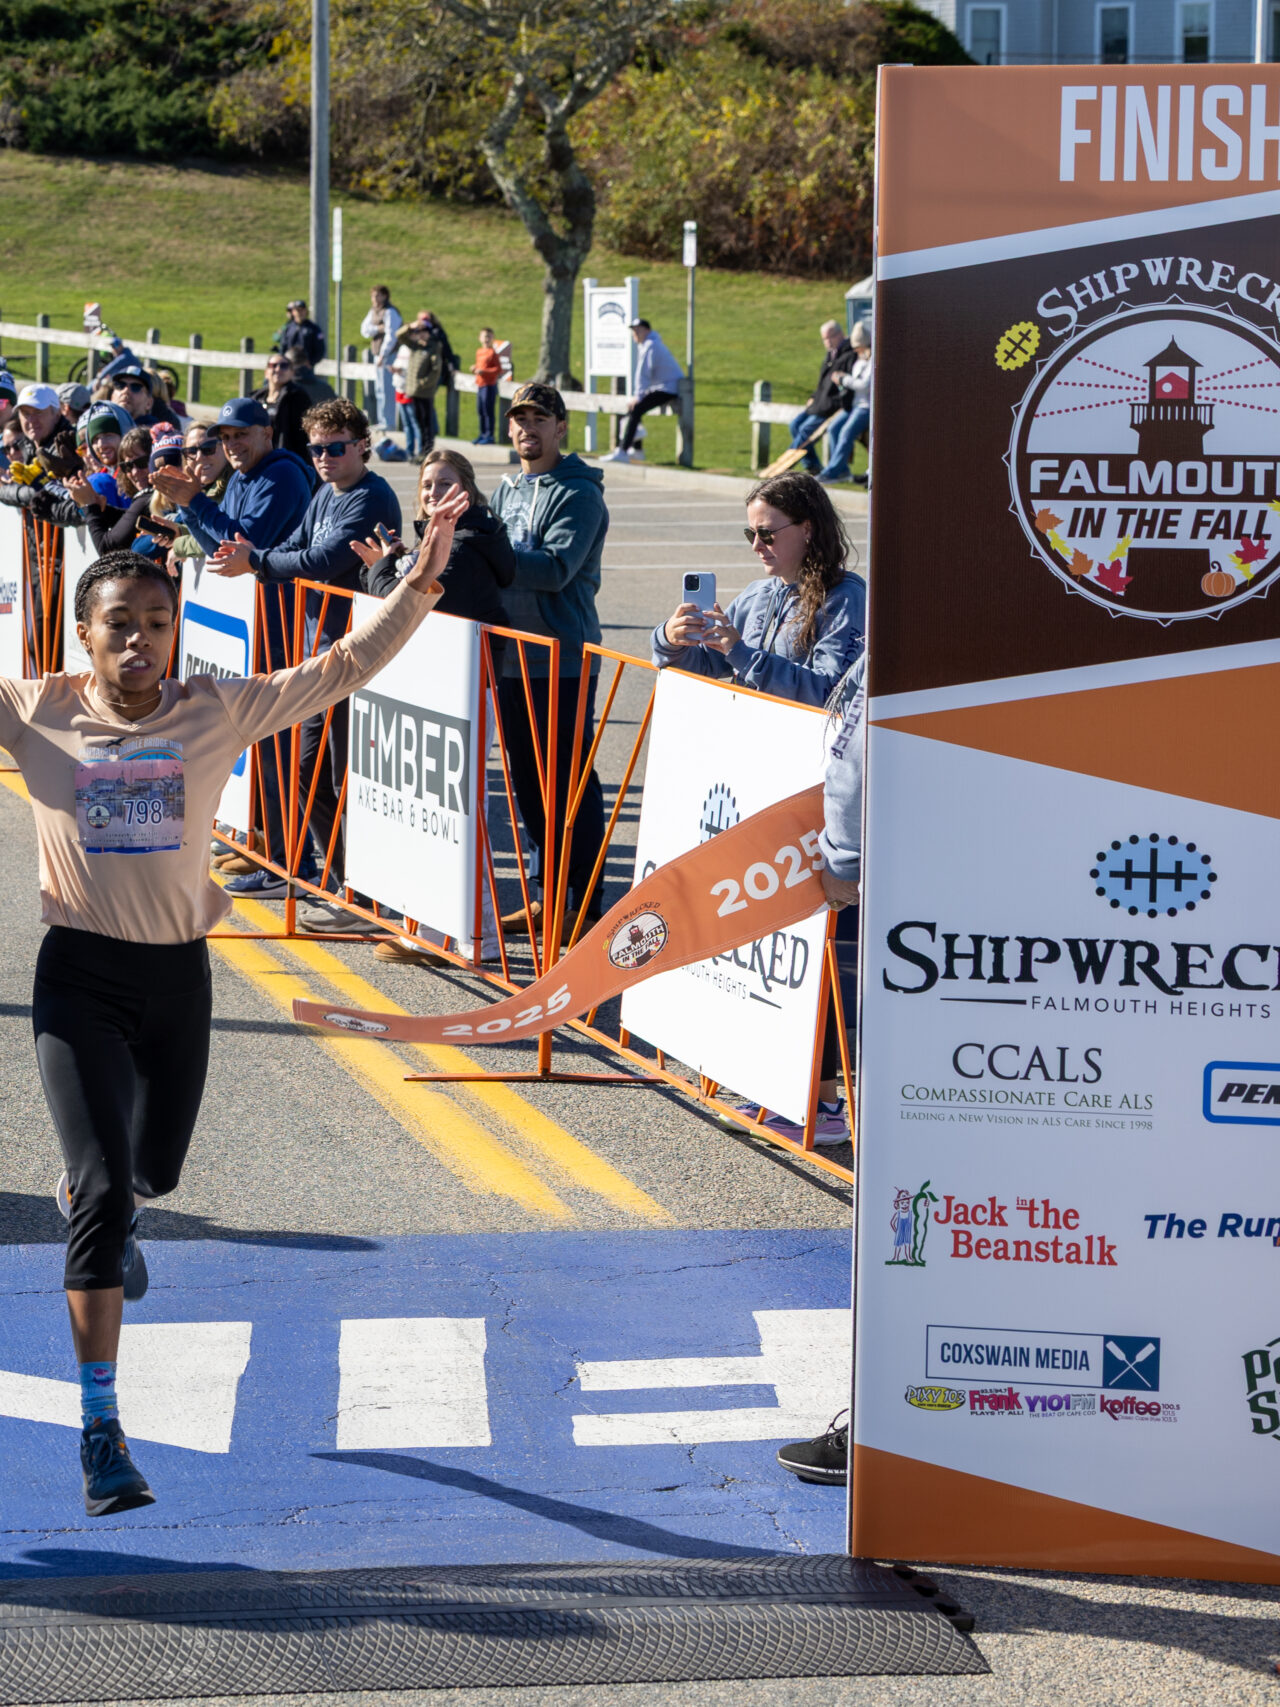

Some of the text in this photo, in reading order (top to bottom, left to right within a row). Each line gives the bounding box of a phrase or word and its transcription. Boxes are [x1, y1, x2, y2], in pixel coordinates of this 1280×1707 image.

[1030, 459, 1280, 496] FALMOUT
[1067, 508, 1272, 541] IN THE FALL
[354, 697, 466, 815] TIMBER
[123, 799, 164, 826] 798
[358, 783, 459, 844] AXE BAR & BOWL
[710, 829, 826, 918] 2025
[713, 971, 747, 1000] HEIGHTS
[441, 983, 572, 1036] 2025
[1031, 995, 1271, 1019] FALMOUTH HEIGHTS
[951, 1042, 1103, 1084] CCALS
[901, 1084, 1153, 1111] COMPASSIONATE CARE ALS
[900, 1110, 945, 1122] LEADING
[958, 1112, 984, 1123] NEW
[986, 1114, 1024, 1125] VISION
[1027, 1117, 1039, 1125] IN
[1042, 1117, 1061, 1127] ALS
[1064, 1117, 1091, 1128] CARE
[1095, 1118, 1126, 1129] SINCE
[1129, 1120, 1153, 1130] 1998
[934, 1195, 1080, 1231] Jack in the
[1144, 1213, 1207, 1239] The
[950, 1229, 1118, 1267] Beanstalk
[940, 1342, 1090, 1371] COXSWAIN MEDIA
[906, 1385, 966, 1404] PIXY 103
[969, 1387, 1022, 1411] Frank
[1024, 1394, 1096, 1412] Y101 FM
[1100, 1394, 1161, 1421] koffee
